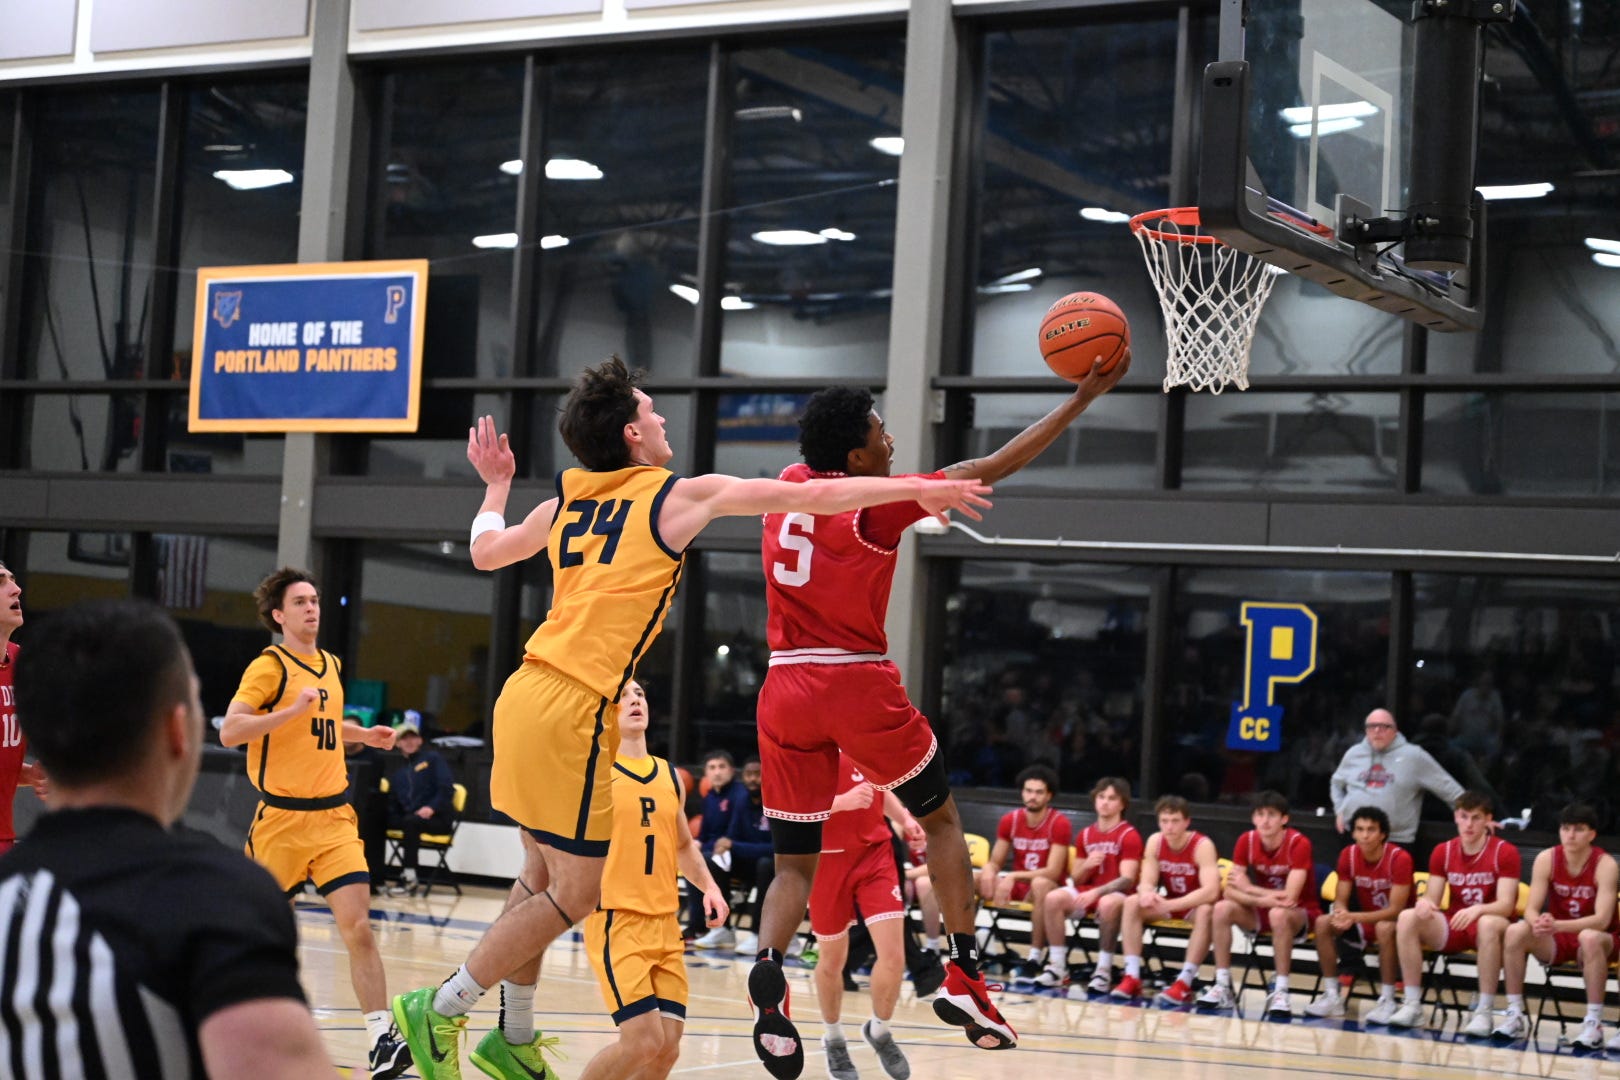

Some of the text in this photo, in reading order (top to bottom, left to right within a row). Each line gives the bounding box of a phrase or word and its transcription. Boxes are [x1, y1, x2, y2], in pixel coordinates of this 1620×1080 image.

[385, 286, 406, 323] P
[249, 320, 363, 346] HOME OF THE
[1045, 317, 1091, 340] ELITE
[214, 347, 398, 373] PORTLAND PANTHERS
[559, 498, 634, 569] 24
[773, 511, 815, 587] 5
[1236, 601, 1319, 715] P
[317, 688, 328, 712] P
[2, 713, 22, 748] 10
[311, 717, 336, 751] 40
[1240, 716, 1270, 741] CC
[639, 796, 656, 827] P
[644, 834, 655, 875] 1
